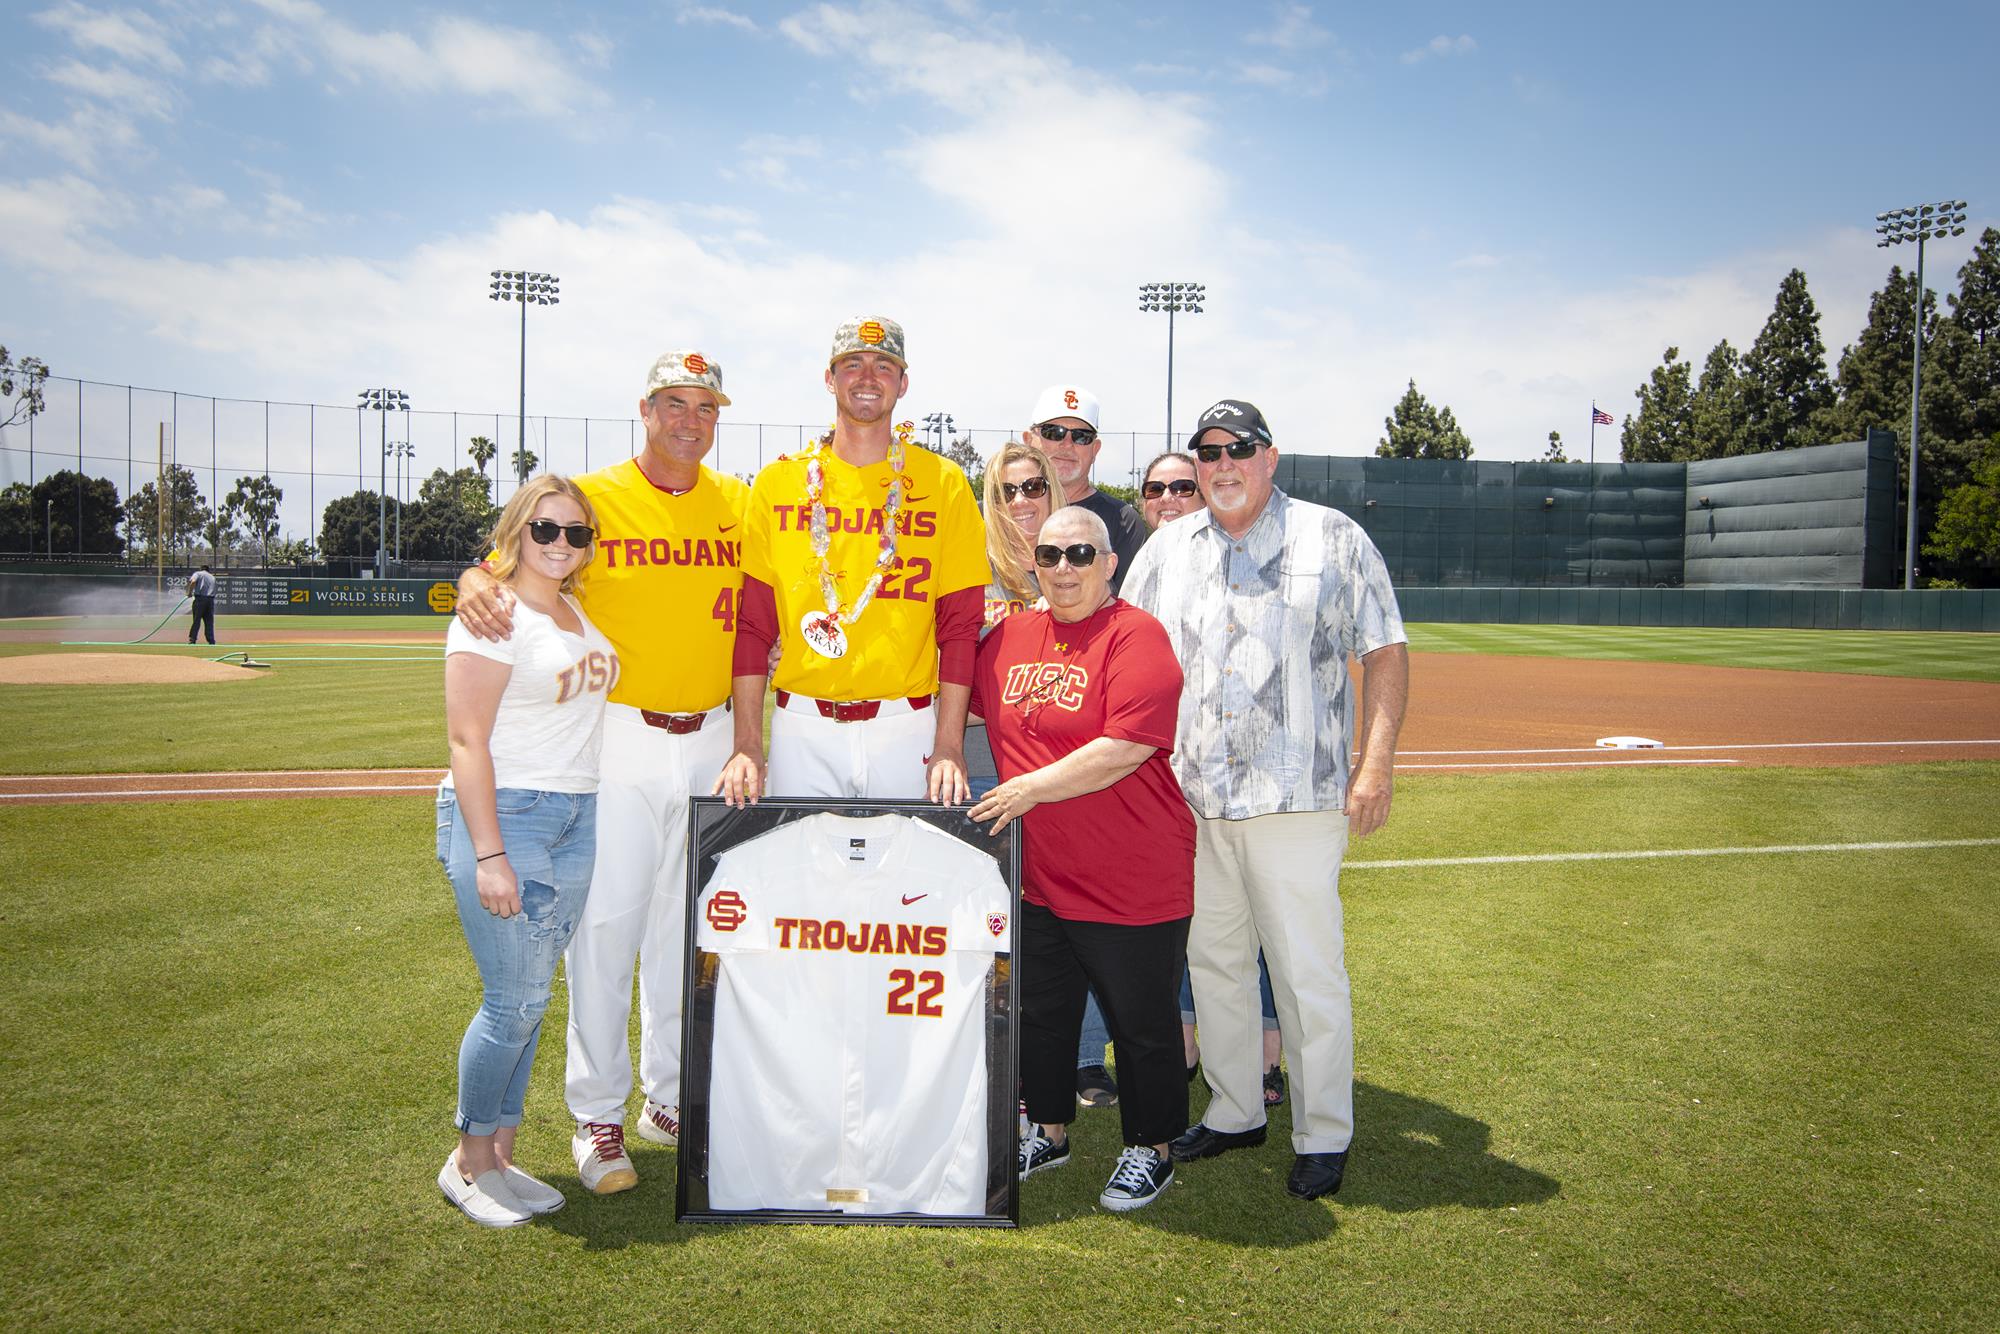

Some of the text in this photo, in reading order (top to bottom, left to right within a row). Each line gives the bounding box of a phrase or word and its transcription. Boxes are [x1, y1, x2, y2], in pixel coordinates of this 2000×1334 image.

[600, 538, 741, 568] TROJAN
[166, 577, 188, 587] 328
[290, 590, 310, 603] 21
[316, 591, 415, 603] WORLD SERIES
[875, 556, 932, 603] 22
[1002, 662, 1089, 712] USC
[774, 917, 948, 957] TROJANS
[886, 968, 945, 1018] 22
